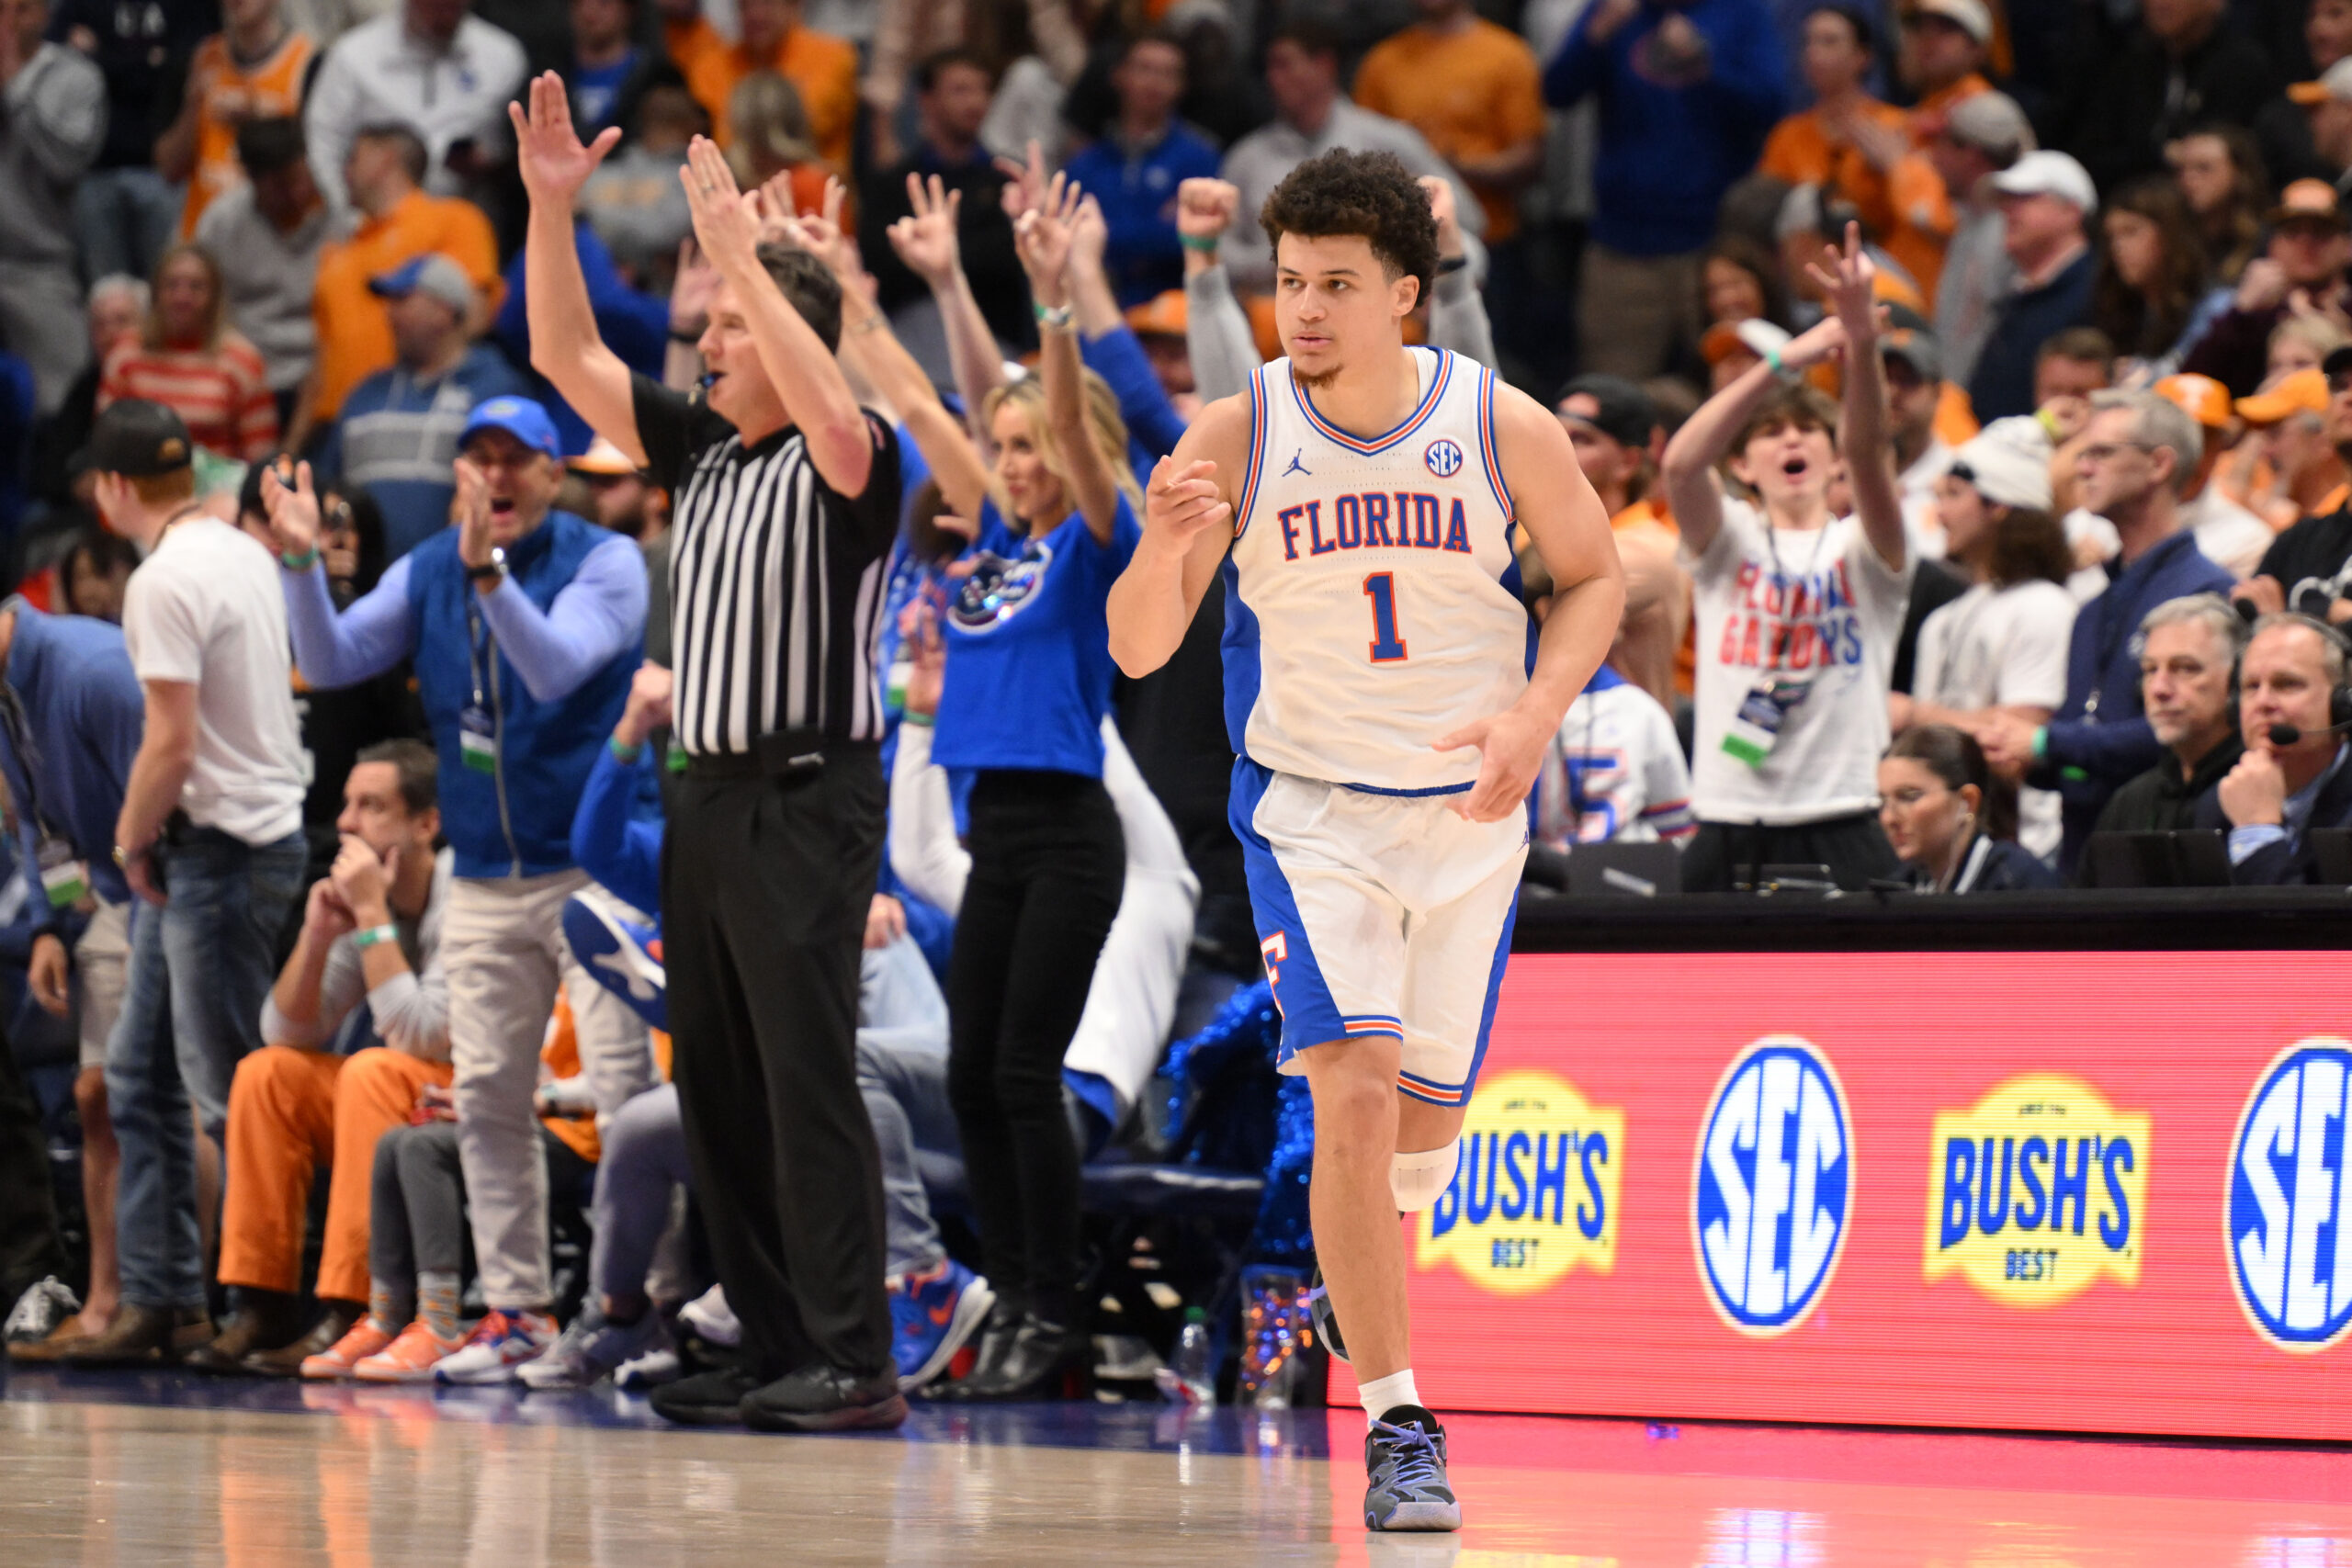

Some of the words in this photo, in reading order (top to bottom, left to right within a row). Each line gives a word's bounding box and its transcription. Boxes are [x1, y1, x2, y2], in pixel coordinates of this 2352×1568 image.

[1427, 440, 1461, 477] SEC
[1277, 491, 1473, 561] FLORIDA
[1363, 570, 1408, 663] 1
[1704, 1056, 1842, 1317] SEC
[1939, 1134, 2135, 1252] BUSH'S
[2242, 1060, 2352, 1328] SE
[2005, 1247, 2059, 1281] BEST
